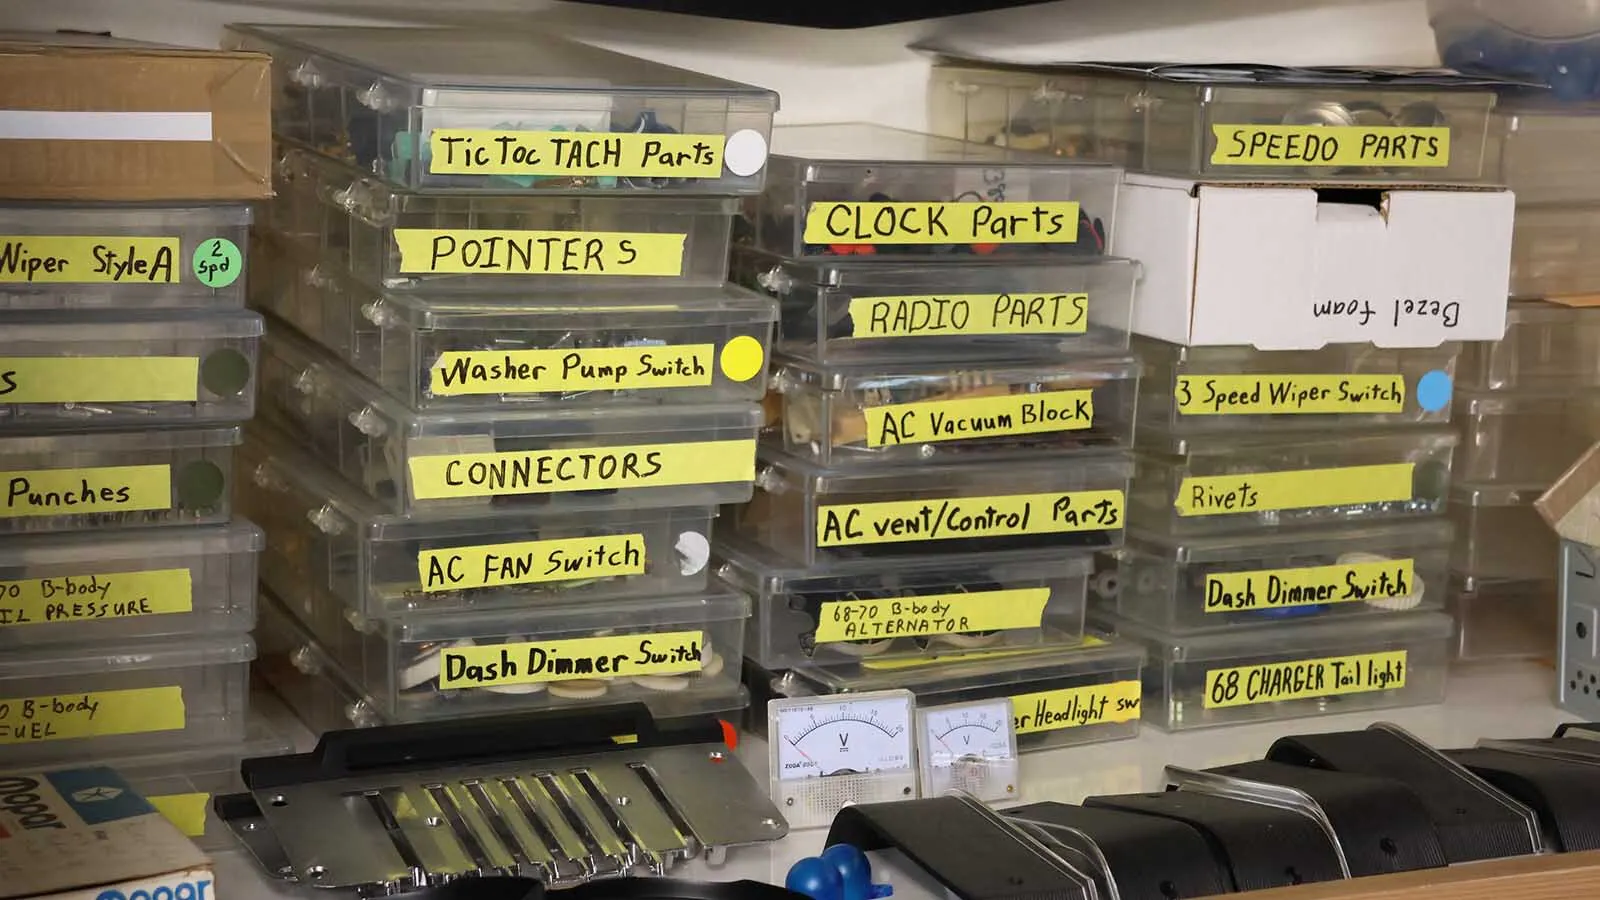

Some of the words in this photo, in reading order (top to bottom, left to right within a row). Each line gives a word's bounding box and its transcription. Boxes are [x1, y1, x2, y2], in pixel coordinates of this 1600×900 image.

[550, 138, 621, 168] TACH
[641, 141, 714, 168] Parts
[1227, 130, 1339, 162] SPEEDO
[1360, 133, 1439, 159] PARTS
[826, 204, 949, 240] CLOCK
[972, 205, 1063, 238] Parts
[92, 245, 147, 281] Style
[149, 246, 172, 282] A
[211, 240, 222, 257] 2
[431, 235, 637, 271] POINTERS
[870, 298, 969, 333] RADIO
[992, 294, 1087, 328] PARTS
[1313, 299, 1376, 325] foam
[1394, 299, 1460, 327] Bezel
[441, 356, 547, 387] Washer
[562, 353, 627, 382] Pump
[636, 354, 705, 377] Switch
[1179, 380, 1192, 406] 3
[1202, 380, 1260, 411] Speed
[1270, 382, 1331, 408] Wiper
[1338, 382, 1401, 404] Switch
[880, 411, 916, 445] AC
[930, 412, 1012, 435] Vacuum
[446, 451, 662, 490] CONNECTORS
[8, 477, 130, 507] Punches
[1192, 482, 1258, 509] Rivets
[823, 508, 864, 542] AC
[1053, 496, 1118, 526] Parts
[428, 555, 465, 587] AC
[483, 553, 533, 583] FAN
[544, 540, 640, 575] Switch
[41, 576, 111, 600] B-body
[1207, 578, 1256, 608] Dash
[1267, 575, 1337, 604] Dimmer
[1341, 569, 1407, 600] Switch
[46, 598, 152, 621] PRESSURE
[833, 605, 878, 622] 68-70
[891, 600, 952, 617] B-body
[845, 618, 969, 637] ALTERNATOR
[445, 650, 517, 683] Dash
[527, 647, 628, 676] Dimmer
[635, 640, 702, 665] Switch
[1212, 670, 1239, 704] 68
[1246, 663, 1324, 701] CHARGER
[1368, 659, 1403, 689] light
[23, 696, 99, 720] B-body
[1034, 695, 1109, 728] Headlight
